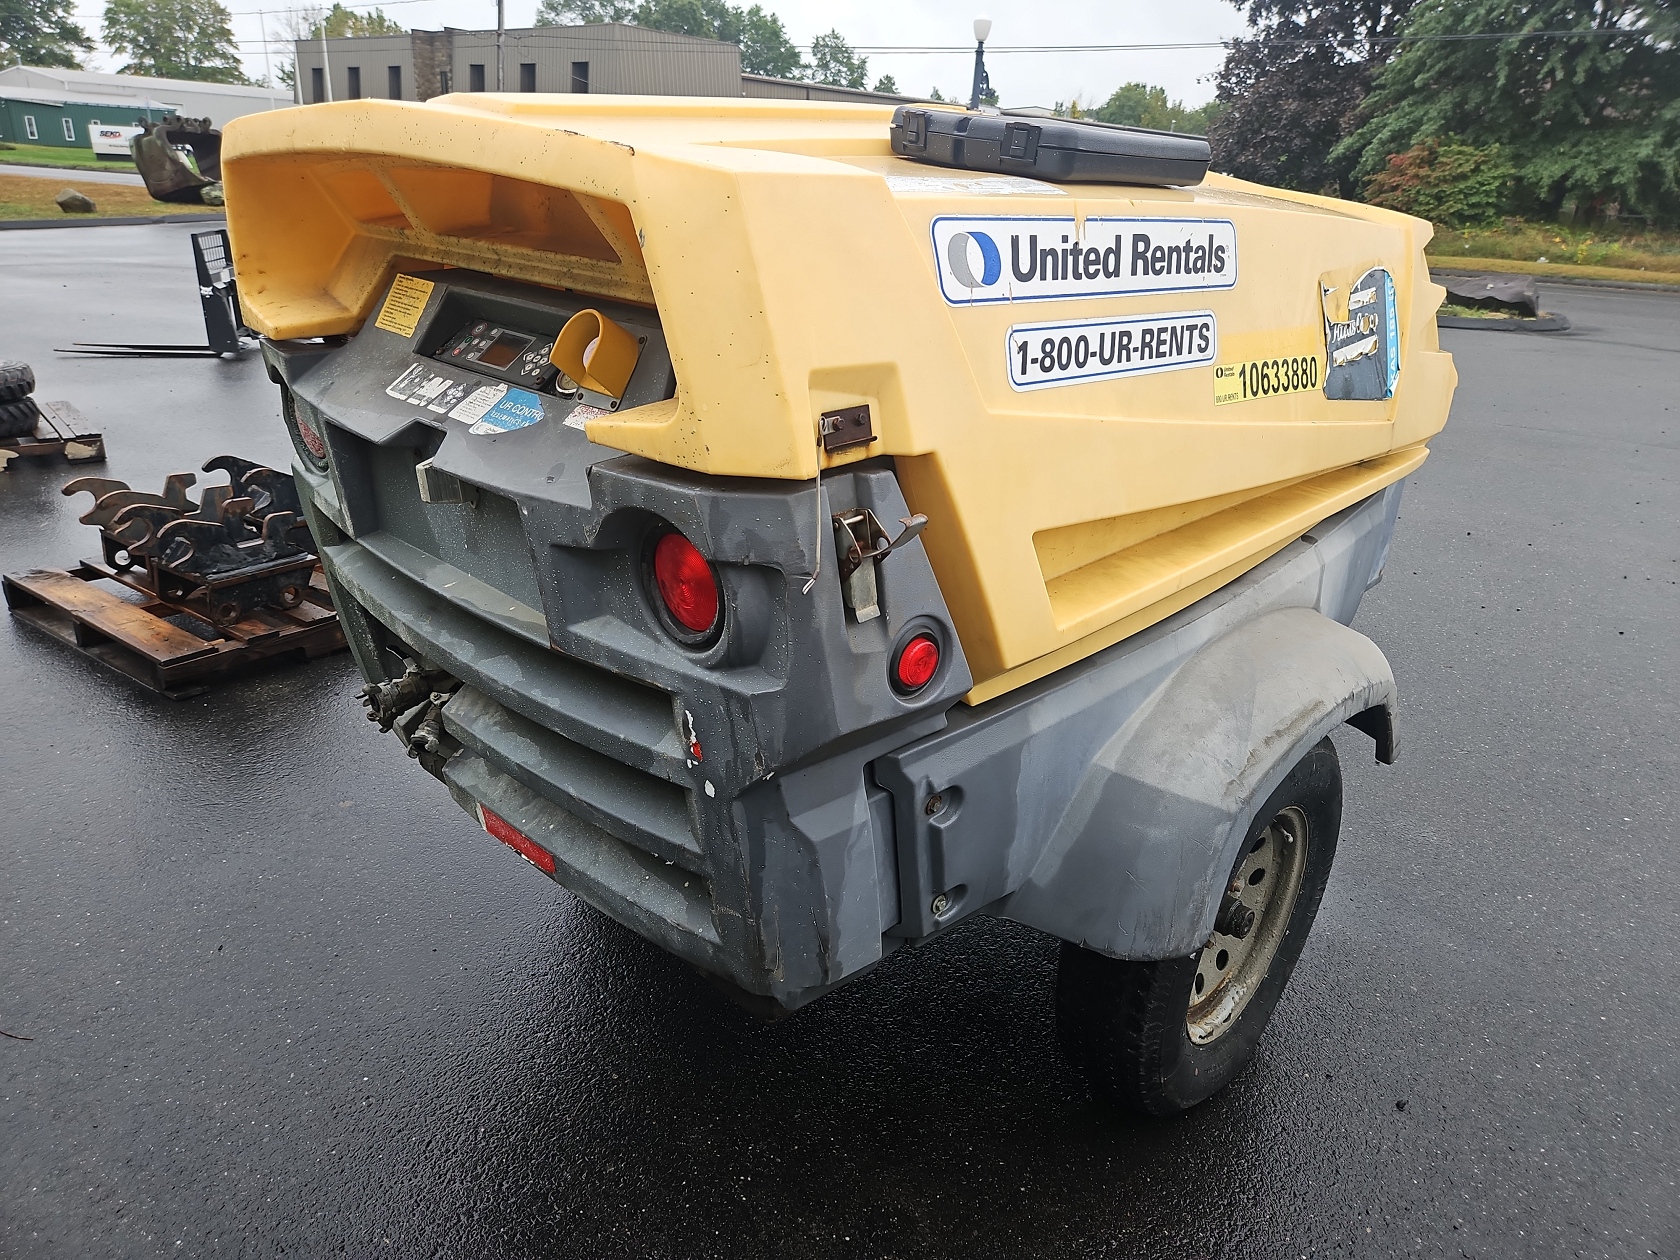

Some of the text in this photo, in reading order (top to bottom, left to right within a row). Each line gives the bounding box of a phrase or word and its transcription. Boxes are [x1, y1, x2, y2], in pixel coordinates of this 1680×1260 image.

[1011, 233, 1227, 283] United Rentals
[1017, 322, 1211, 376] 1-800-UR-RENTS
[1239, 356, 1318, 399] 10633880
[499, 400, 512, 412] UR
